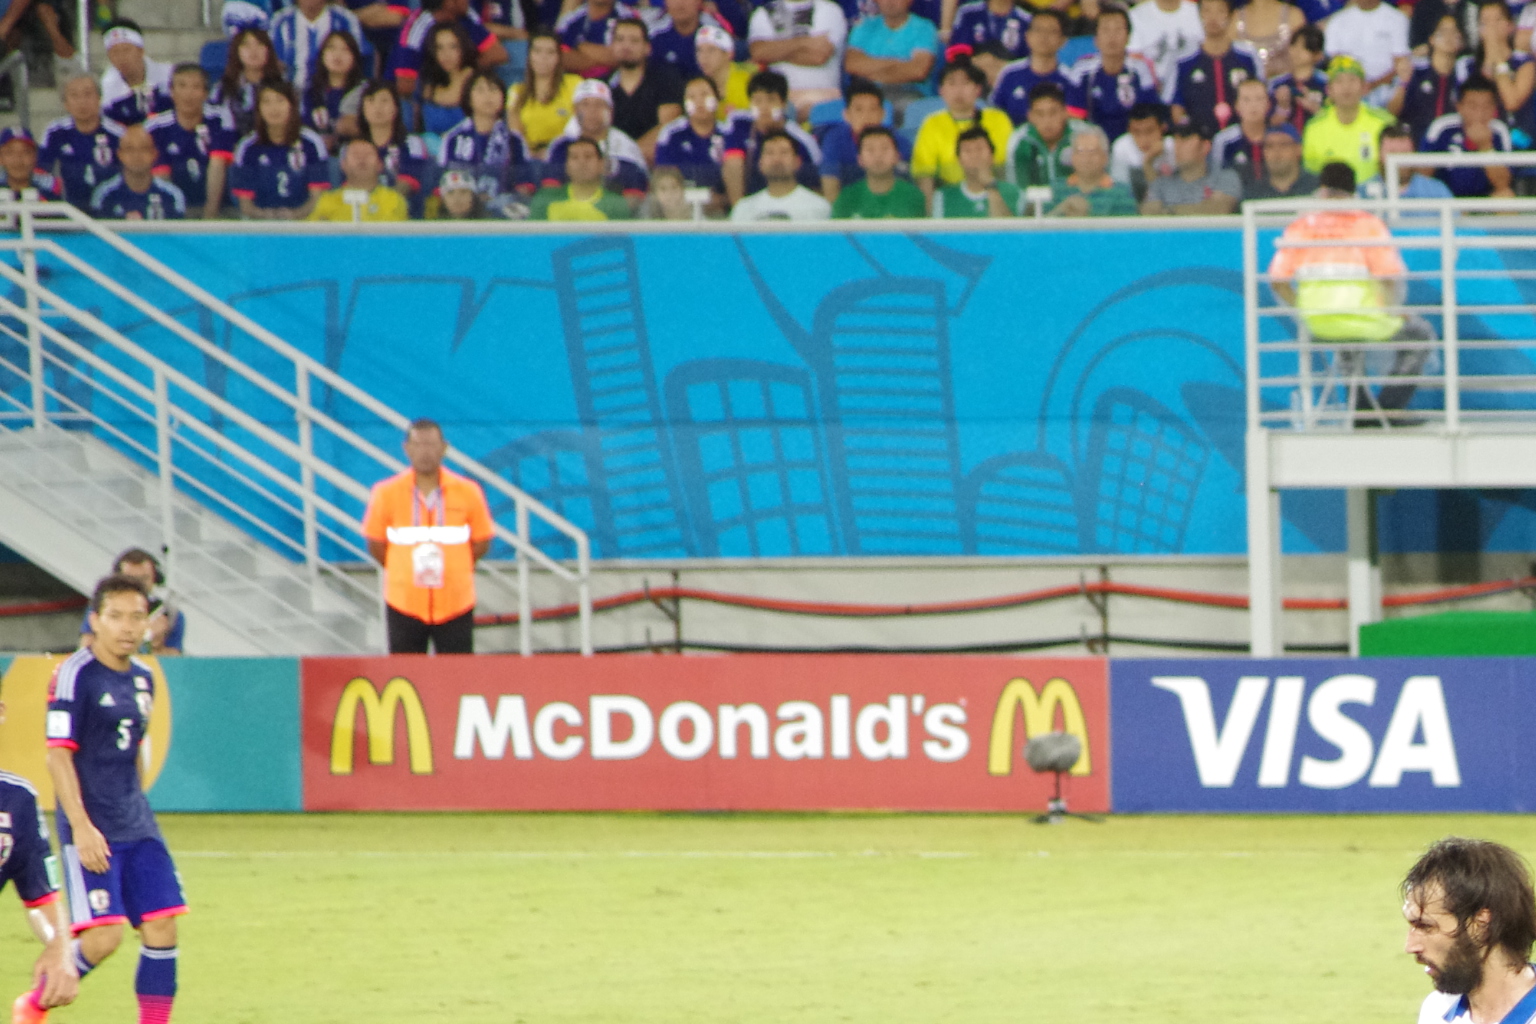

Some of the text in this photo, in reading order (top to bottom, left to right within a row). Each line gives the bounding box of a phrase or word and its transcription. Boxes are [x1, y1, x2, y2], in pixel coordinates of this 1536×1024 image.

[116, 717, 134, 751] 5
[453, 693, 972, 763] McDonald's
[1150, 673, 1462, 788] VISA
